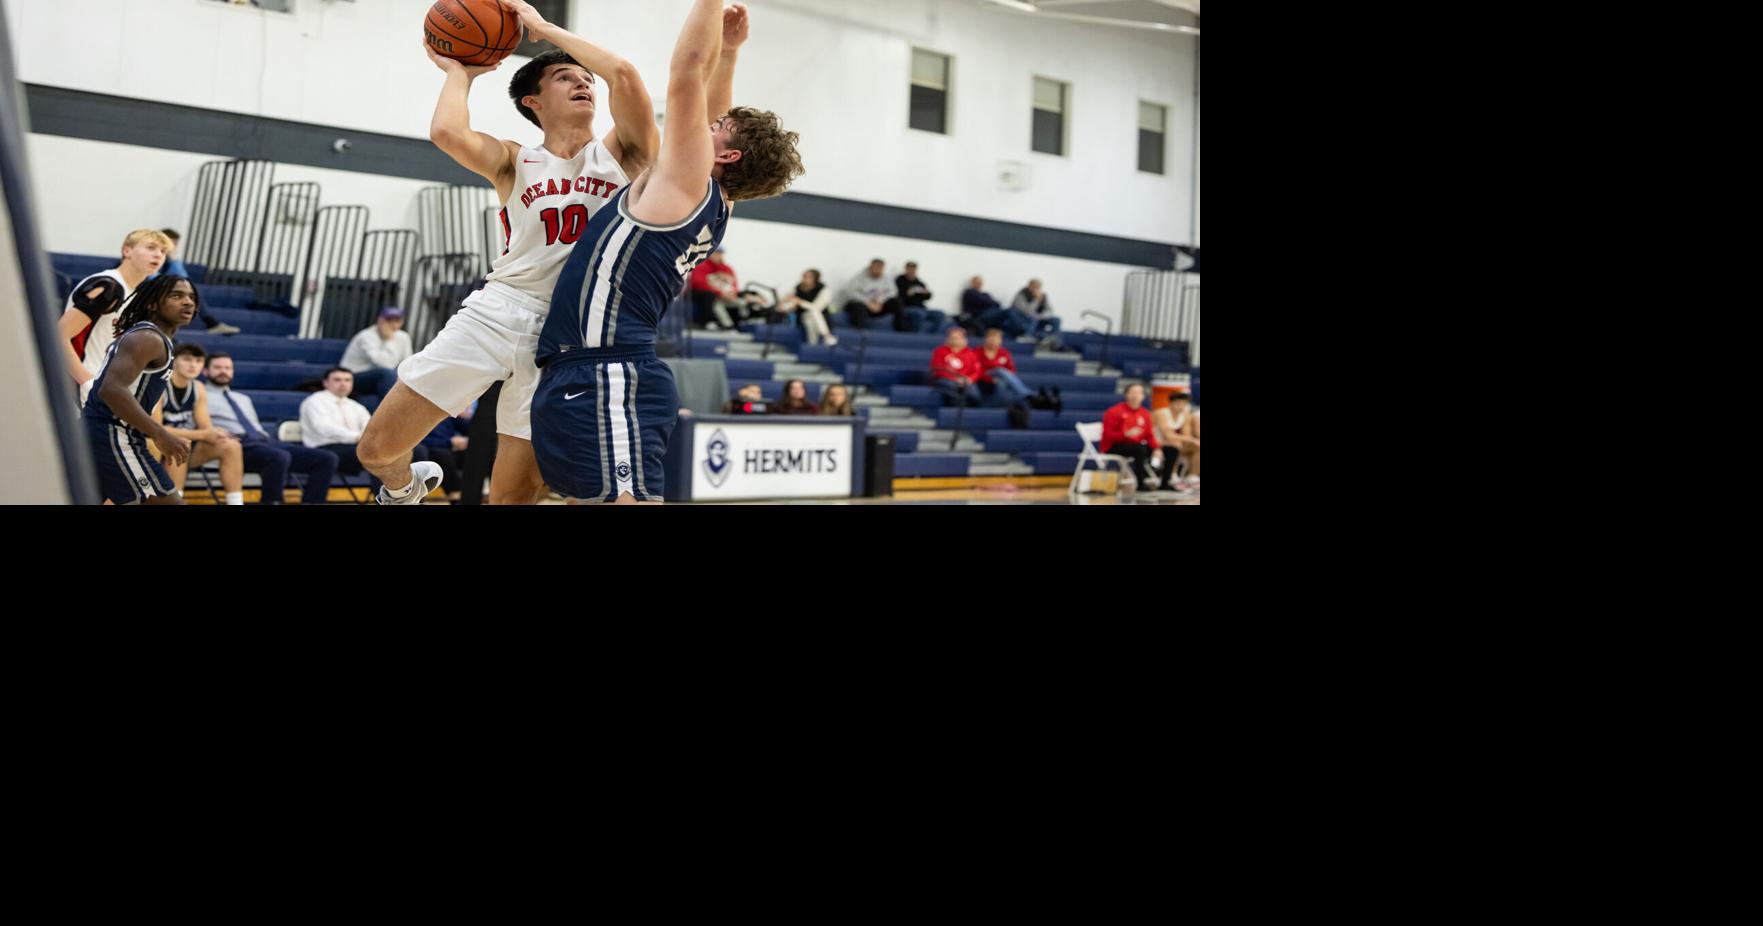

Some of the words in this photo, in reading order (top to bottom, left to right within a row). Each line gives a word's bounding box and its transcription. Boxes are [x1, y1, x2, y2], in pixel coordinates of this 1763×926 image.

[520, 178, 571, 209] OCEAN
[574, 176, 618, 199] CITY
[540, 204, 588, 246] 10
[744, 449, 837, 473] HERMITS
